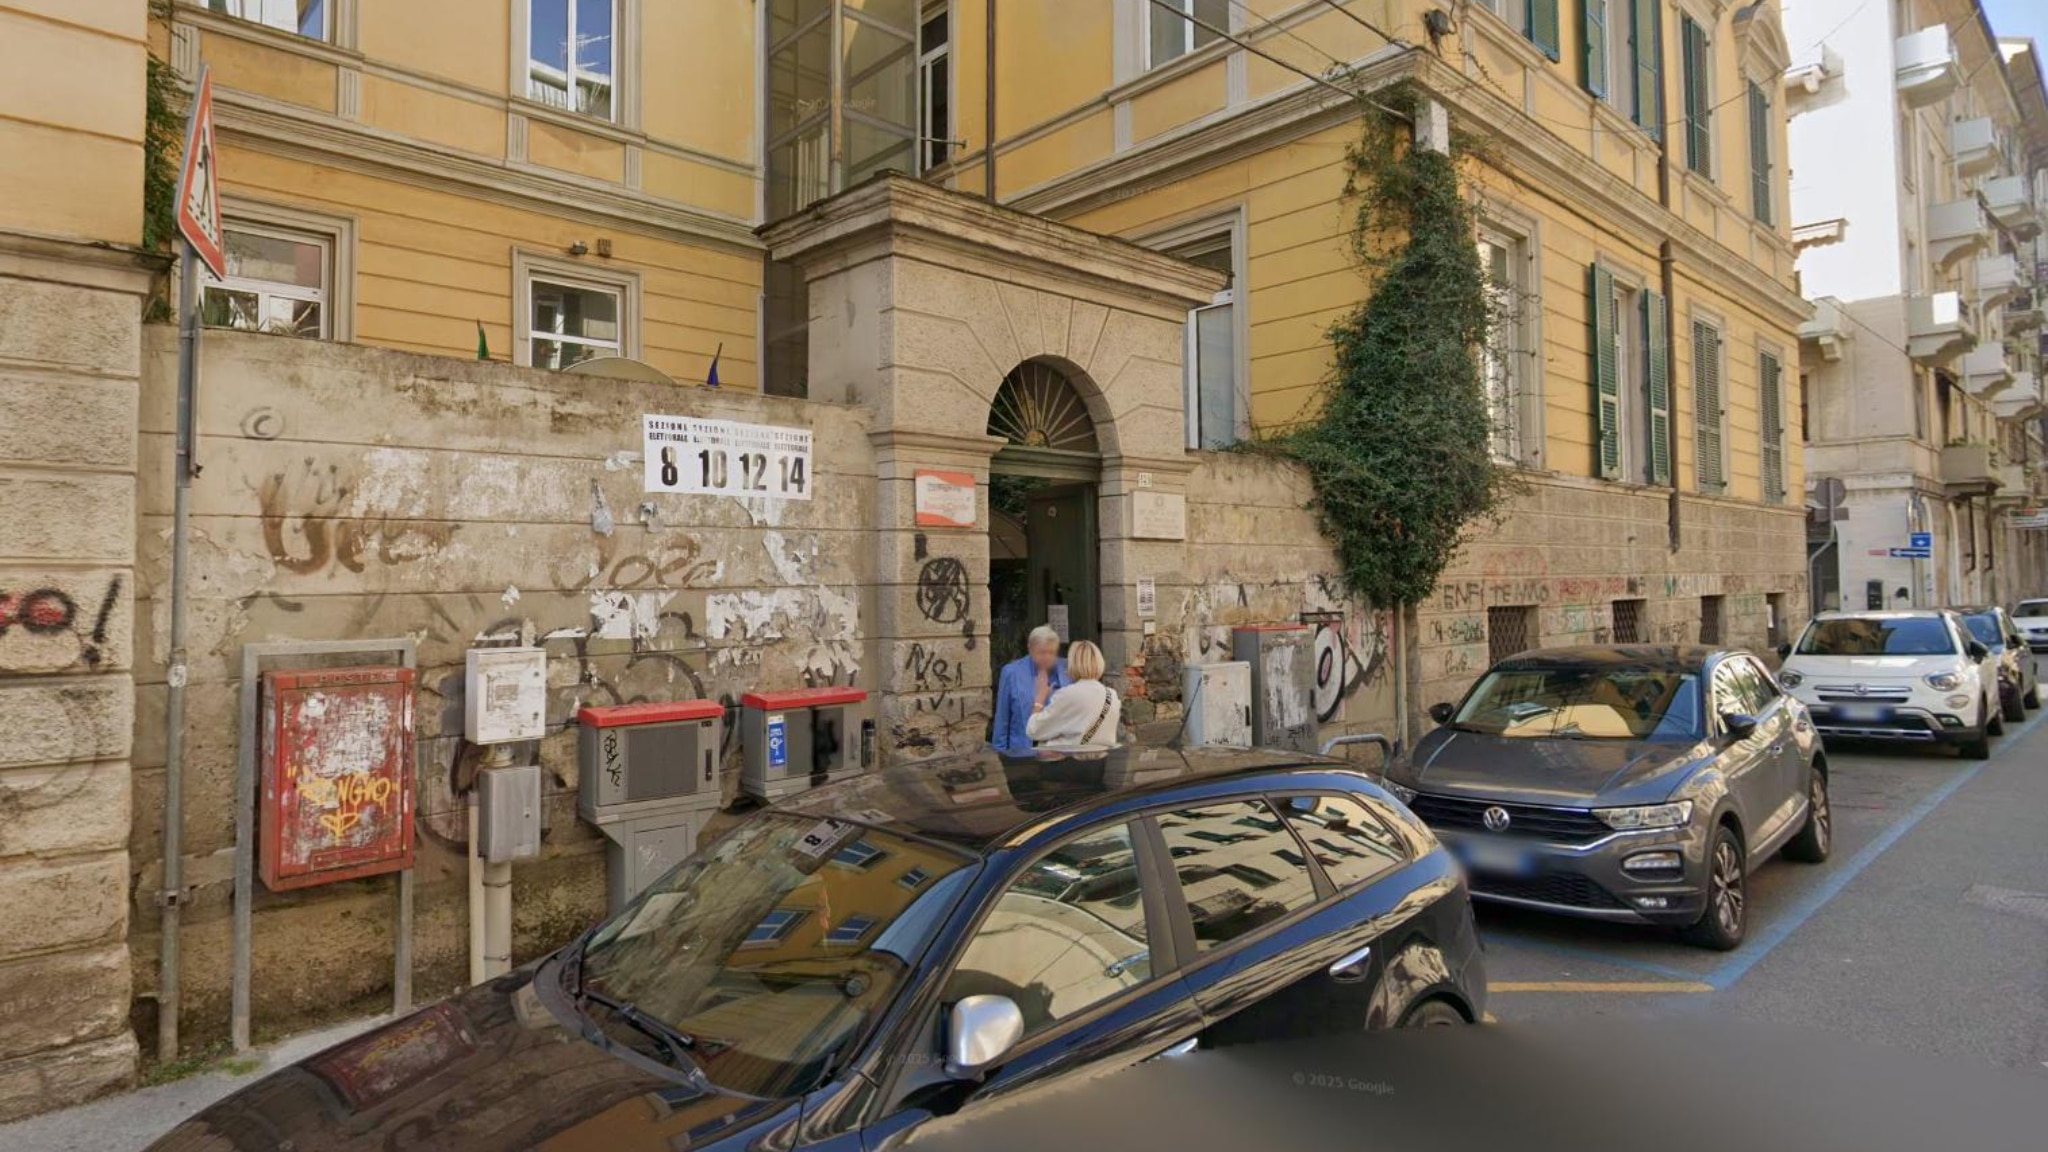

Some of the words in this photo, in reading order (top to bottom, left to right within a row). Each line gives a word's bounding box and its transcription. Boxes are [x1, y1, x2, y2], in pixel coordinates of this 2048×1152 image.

[661, 446, 678, 487] 8
[698, 449, 728, 489] 10
[739, 452, 767, 491] 12
[778, 455, 805, 493] 14
